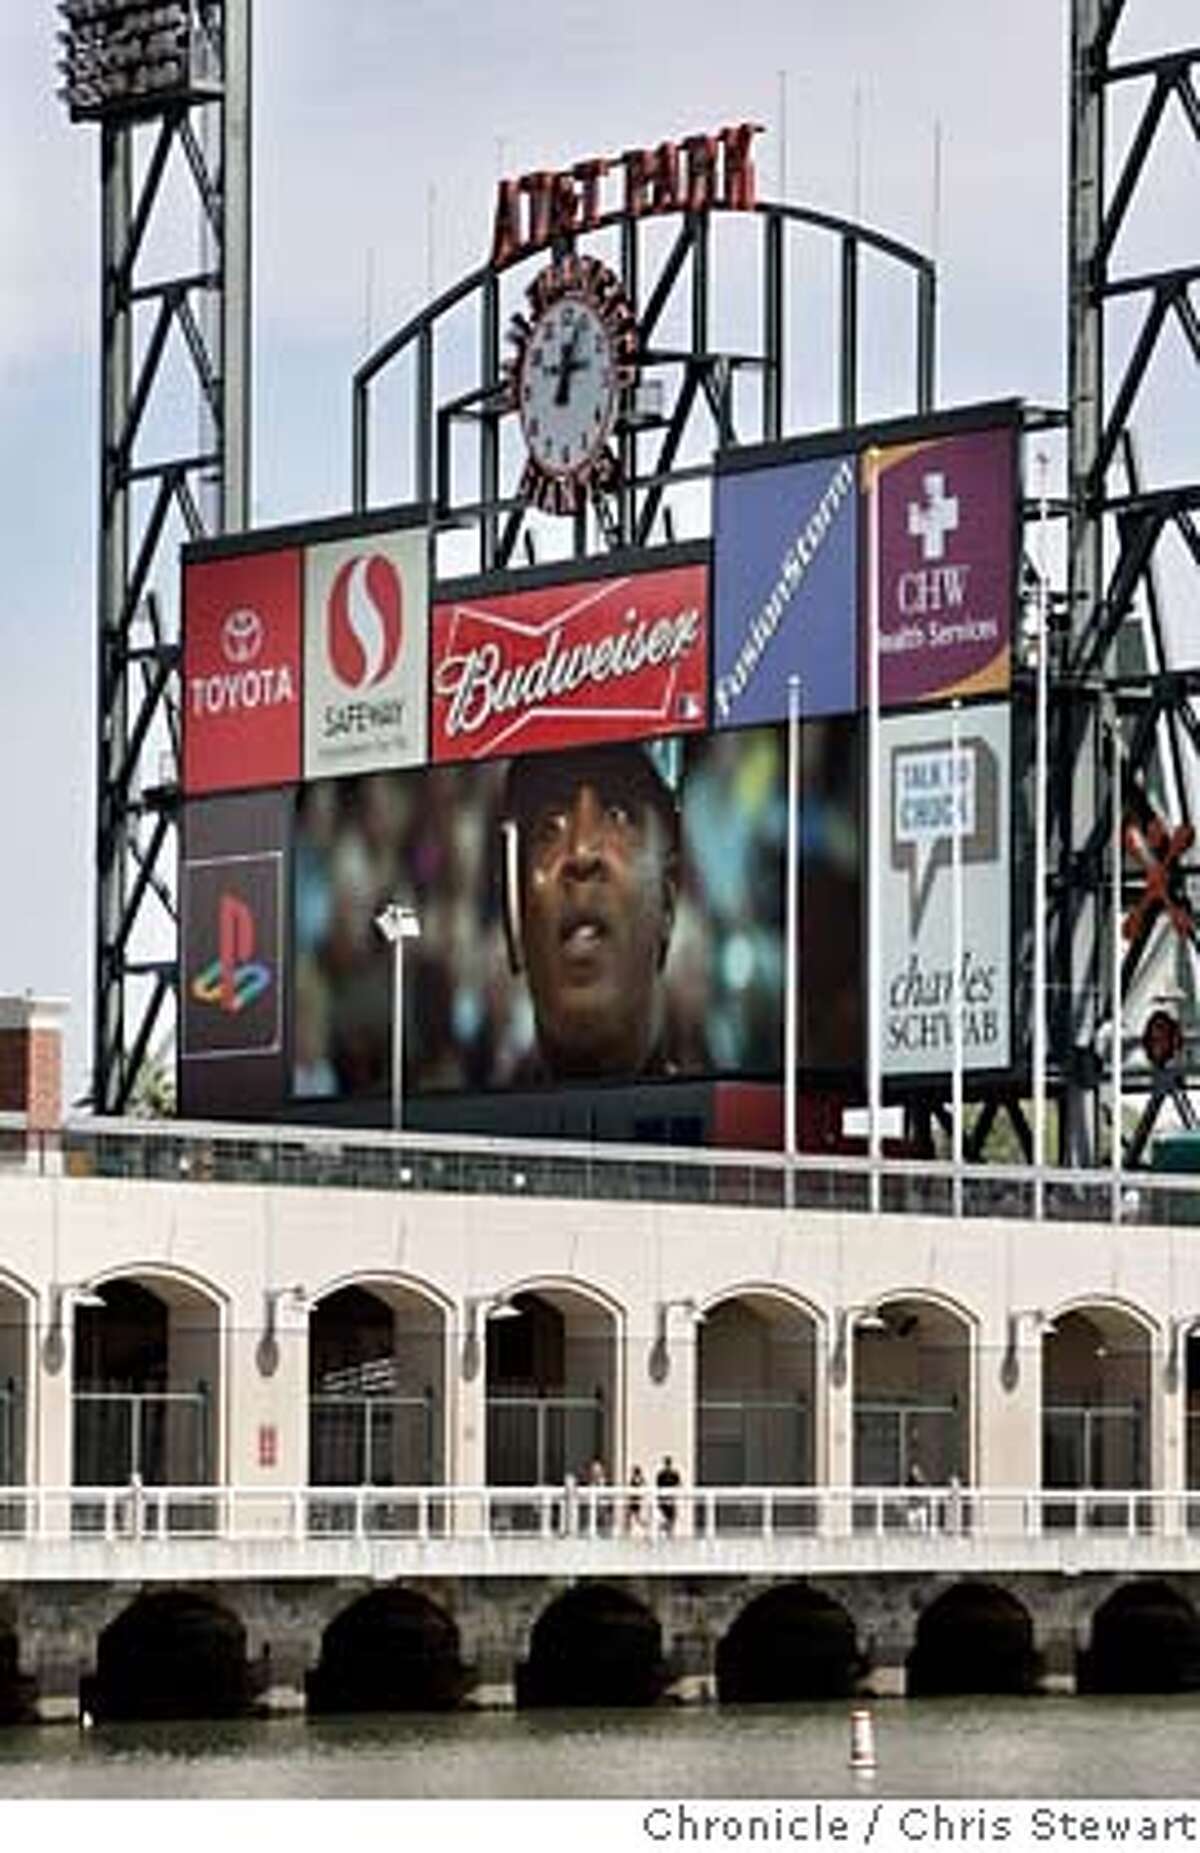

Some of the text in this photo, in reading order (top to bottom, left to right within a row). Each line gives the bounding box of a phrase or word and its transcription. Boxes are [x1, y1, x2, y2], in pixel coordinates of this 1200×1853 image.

[622, 123, 764, 216] PARK
[898, 564, 970, 614] CHW
[878, 617, 998, 653] ealth Services
[191, 664, 293, 717] TOYOTA
[434, 607, 700, 737] Budweiser
[322, 701, 406, 738] SAFEWAY
[902, 760, 941, 789] TALK
